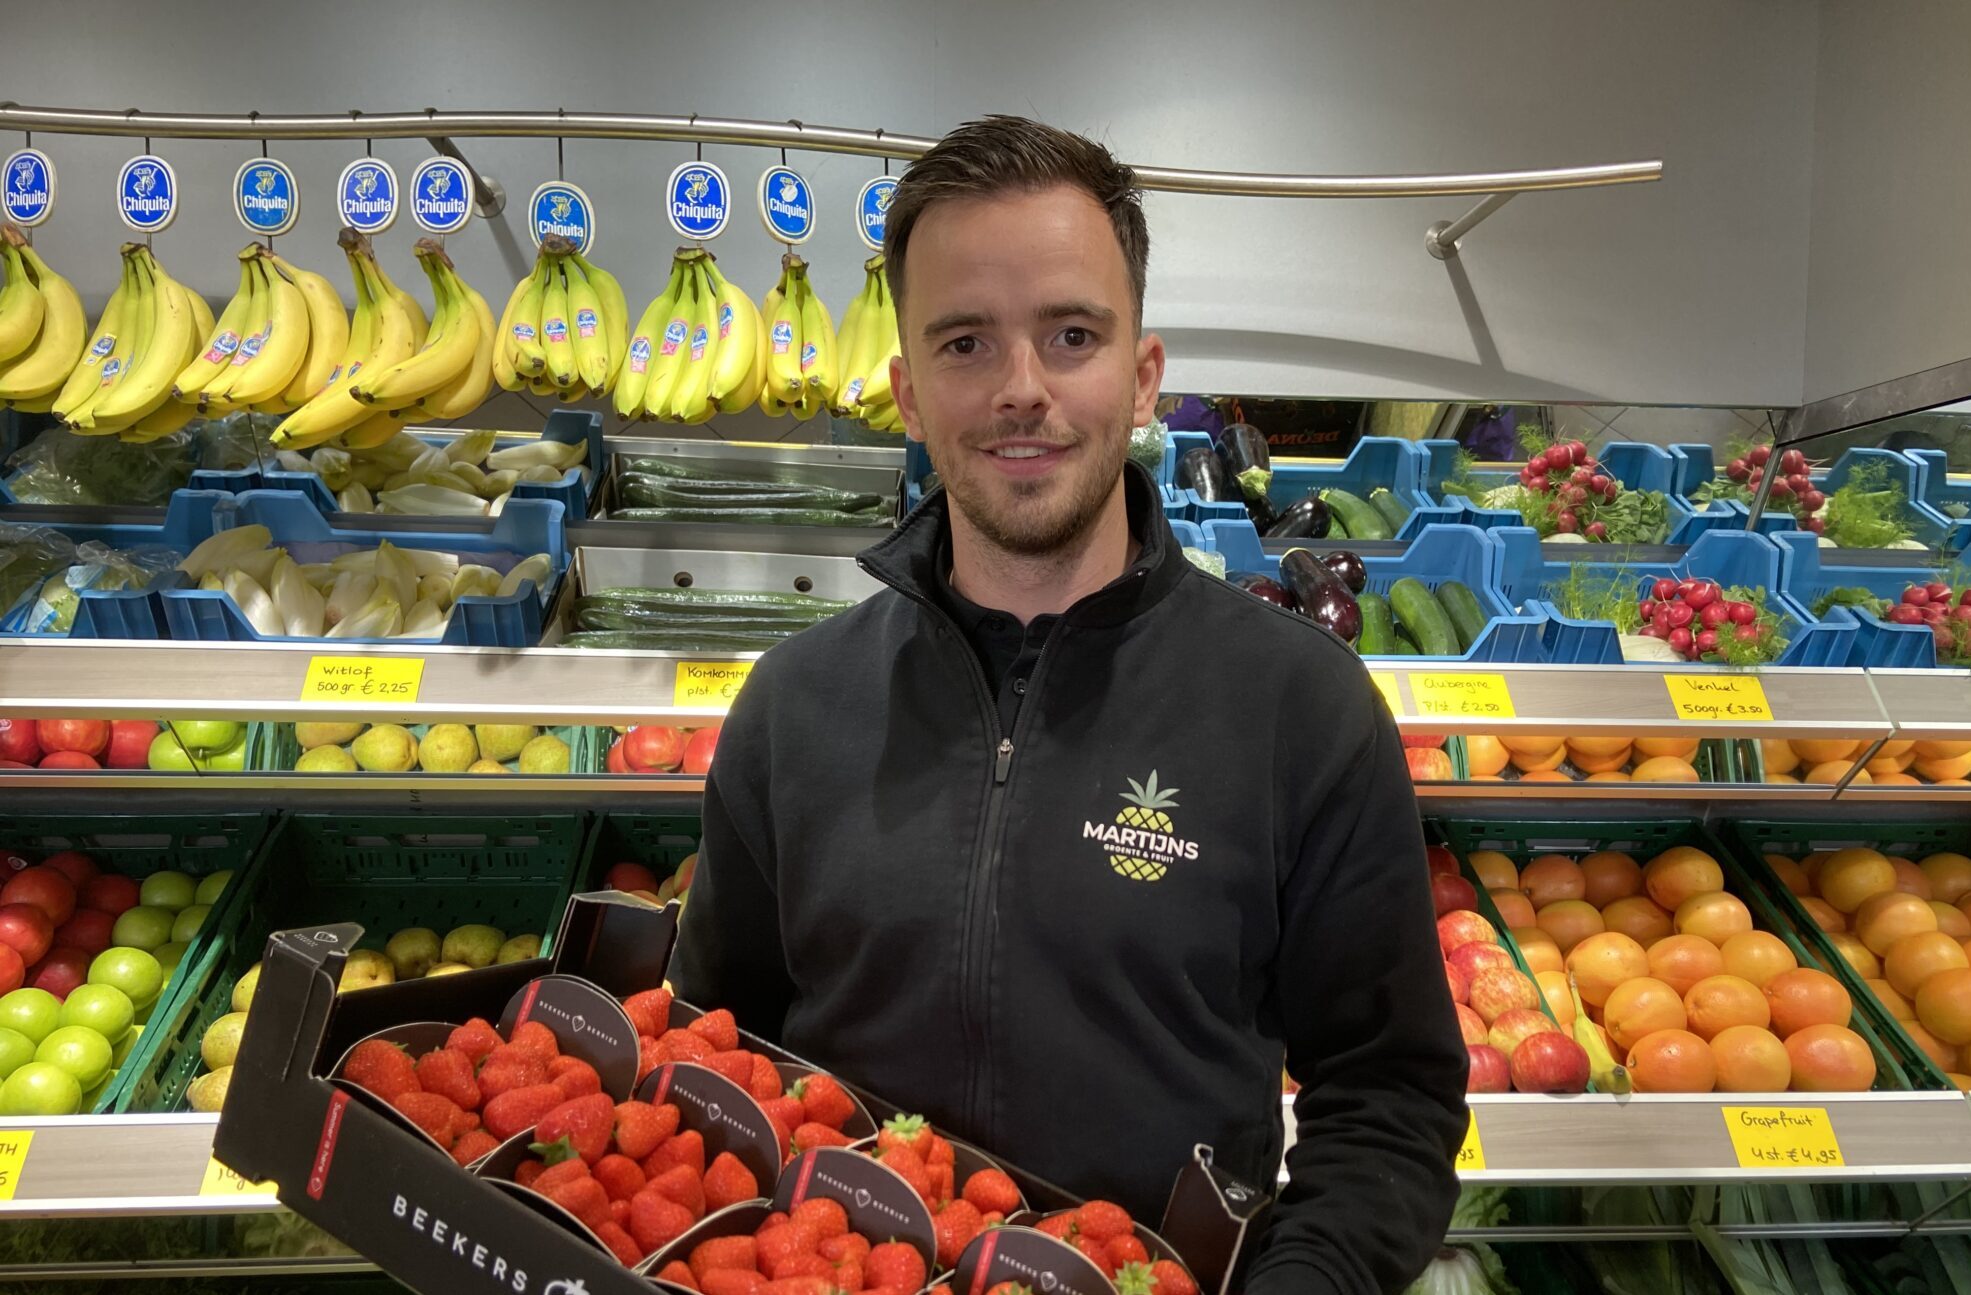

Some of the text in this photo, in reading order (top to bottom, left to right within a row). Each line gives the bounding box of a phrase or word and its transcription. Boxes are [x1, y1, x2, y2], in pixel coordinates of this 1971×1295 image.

[6, 190, 47, 210] Chiquita
[123, 196, 170, 216] Chiquita
[244, 195, 288, 212] Chiquita
[344, 198, 392, 218] Chiquita
[416, 198, 465, 218] Chiquita
[769, 198, 808, 219] Chiquita
[673, 201, 724, 223] Chiquita
[539, 219, 584, 237] Chiquita
[323, 666, 373, 679] Witlof
[317, 682, 339, 692] 500
[360, 679, 375, 695] €
[1424, 678, 1493, 694] Aubergine
[1685, 679, 1741, 692] Venkel
[1083, 821, 1199, 860] MARTIJNS
[1103, 843, 1174, 864] GROENTE & FRUIT
[1740, 1110, 1813, 1128] Grapefruit
[393, 1193, 529, 1292] BEEKERS
